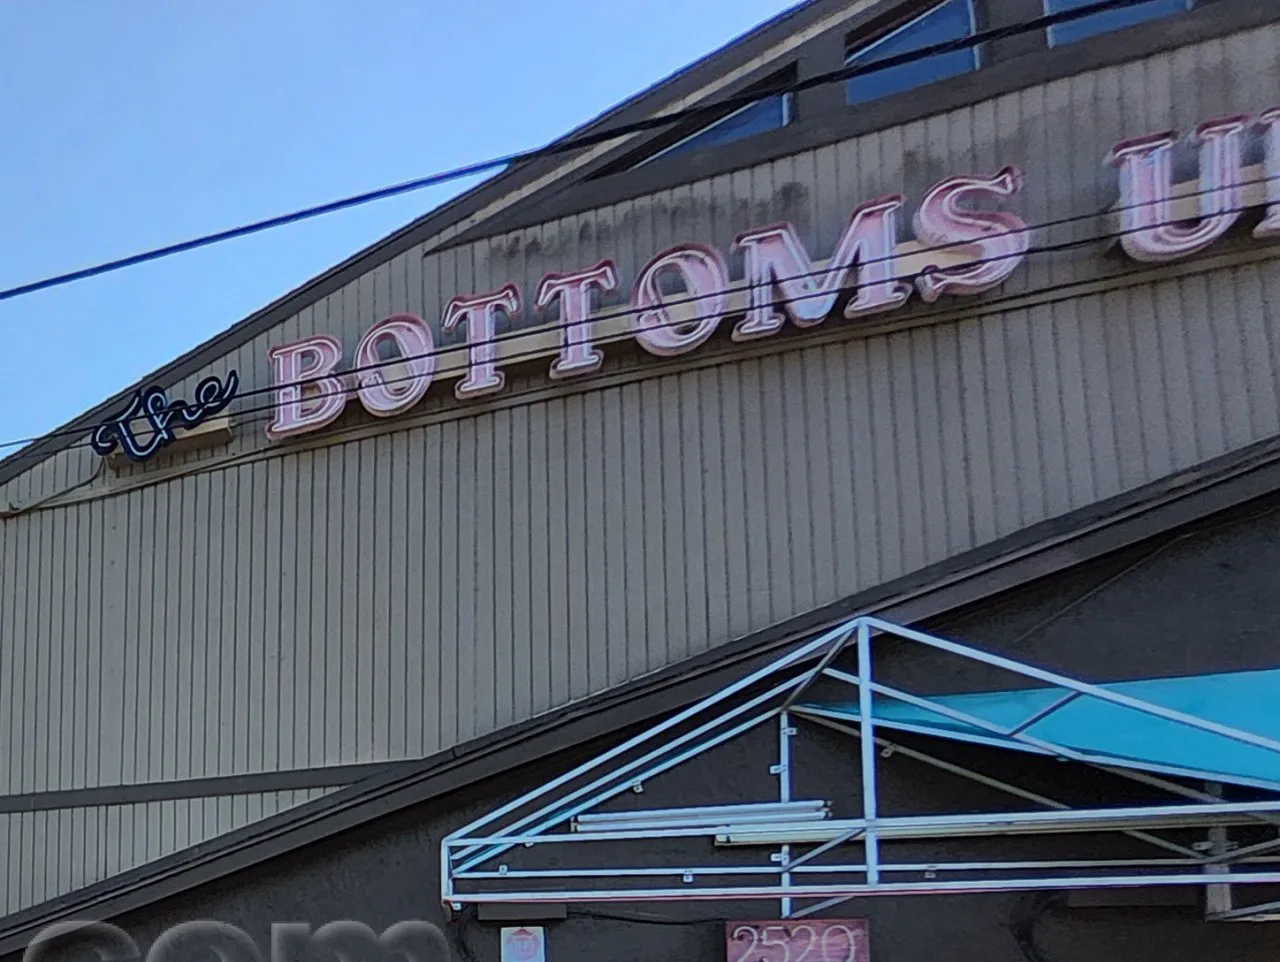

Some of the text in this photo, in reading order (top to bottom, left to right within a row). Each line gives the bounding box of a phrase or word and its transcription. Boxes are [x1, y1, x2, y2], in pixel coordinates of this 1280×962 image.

[92, 105, 1280, 463] The BOTTOMS U
